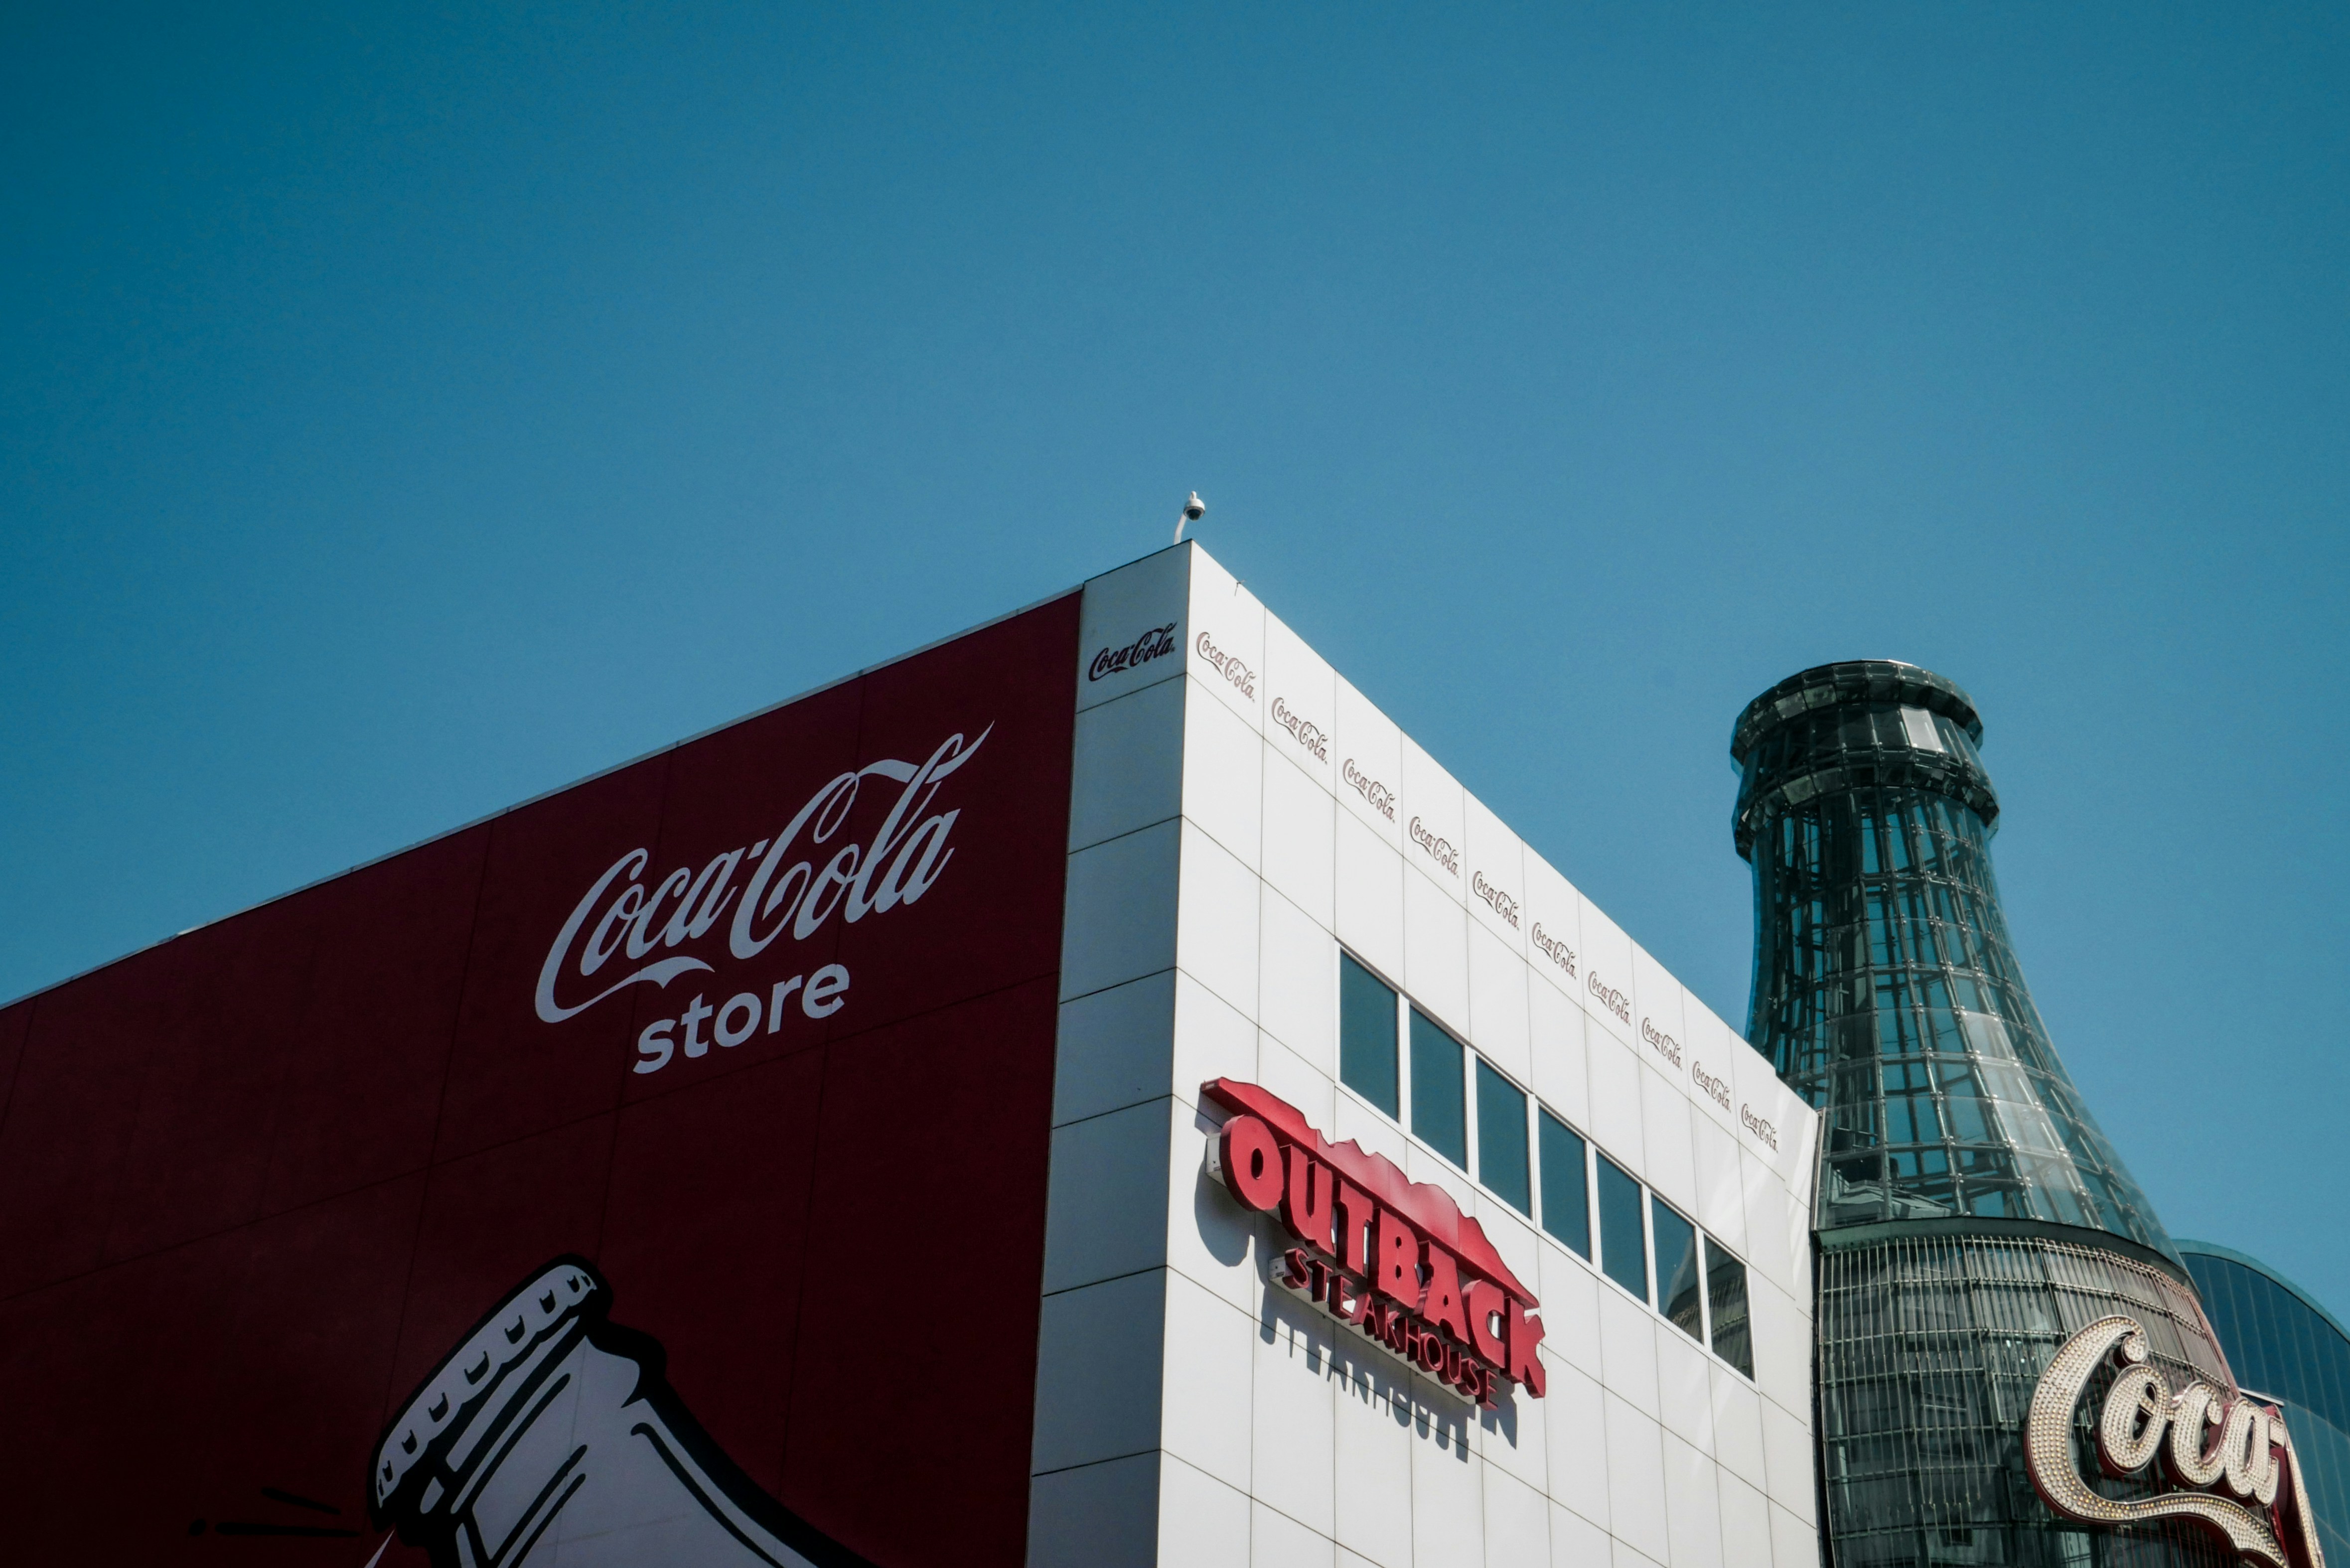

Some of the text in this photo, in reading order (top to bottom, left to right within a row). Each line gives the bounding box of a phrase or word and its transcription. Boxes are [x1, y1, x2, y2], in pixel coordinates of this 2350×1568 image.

[1088, 622, 1177, 682] Coca-Cola
[1196, 631, 1255, 699] Coca-Cola
[1271, 697, 1327, 762] Coca-Cola
[1342, 758, 1395, 821] Coca-Cola
[535, 720, 995, 1023] Coca-Cola
[1409, 816, 1459, 875] Coca-Cola
[1472, 870, 1519, 928] Coca-Cola
[1531, 922, 1577, 978] Coca-Cola
[633, 964, 850, 1074] store
[1588, 971, 1630, 1024] Coca-Cola
[1641, 1017, 1682, 1071] Coca-Cola
[1692, 1061, 1730, 1111] Coca-Cola
[1741, 1103, 1778, 1154] Coca-Cola
[1219, 1114, 1546, 1399] OUTBACK
[1282, 1248, 1498, 1412] STEAKHOUSE
